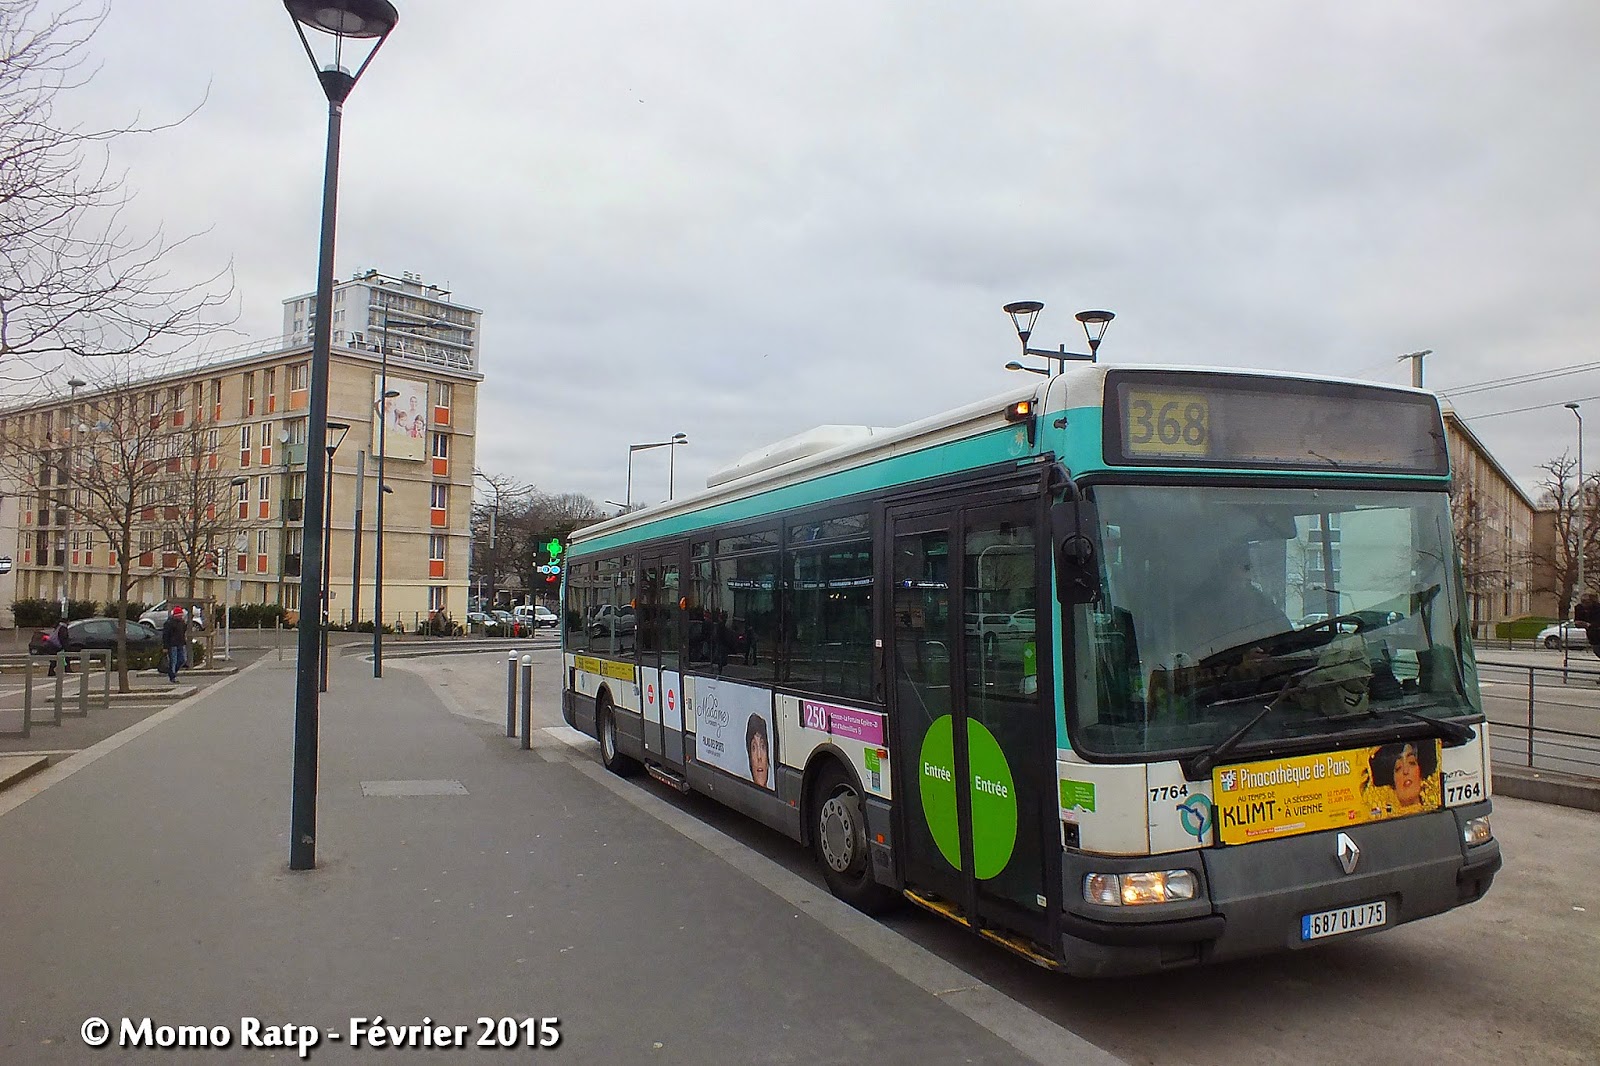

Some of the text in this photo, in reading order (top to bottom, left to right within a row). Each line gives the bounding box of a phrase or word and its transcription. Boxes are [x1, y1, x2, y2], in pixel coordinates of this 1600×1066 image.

[1131, 399, 1207, 446] 368
[806, 704, 826, 730] 250
[924, 762, 951, 782] Entrée
[1240, 756, 1351, 789] Pinacothèque de Paris
[975, 775, 1008, 798] Entrée
[1150, 784, 1188, 802] 7764
[1238, 791, 1275, 803] AU TEMPS DE
[1293, 792, 1322, 803] SÉCESSION
[1447, 782, 1480, 803] 7764
[1223, 800, 1275, 828] KLIMT
[1285, 806, 1292, 818] À
[1294, 803, 1323, 816] VIENNE
[1314, 912, 1337, 934] 687
[1368, 904, 1382, 924] 75
